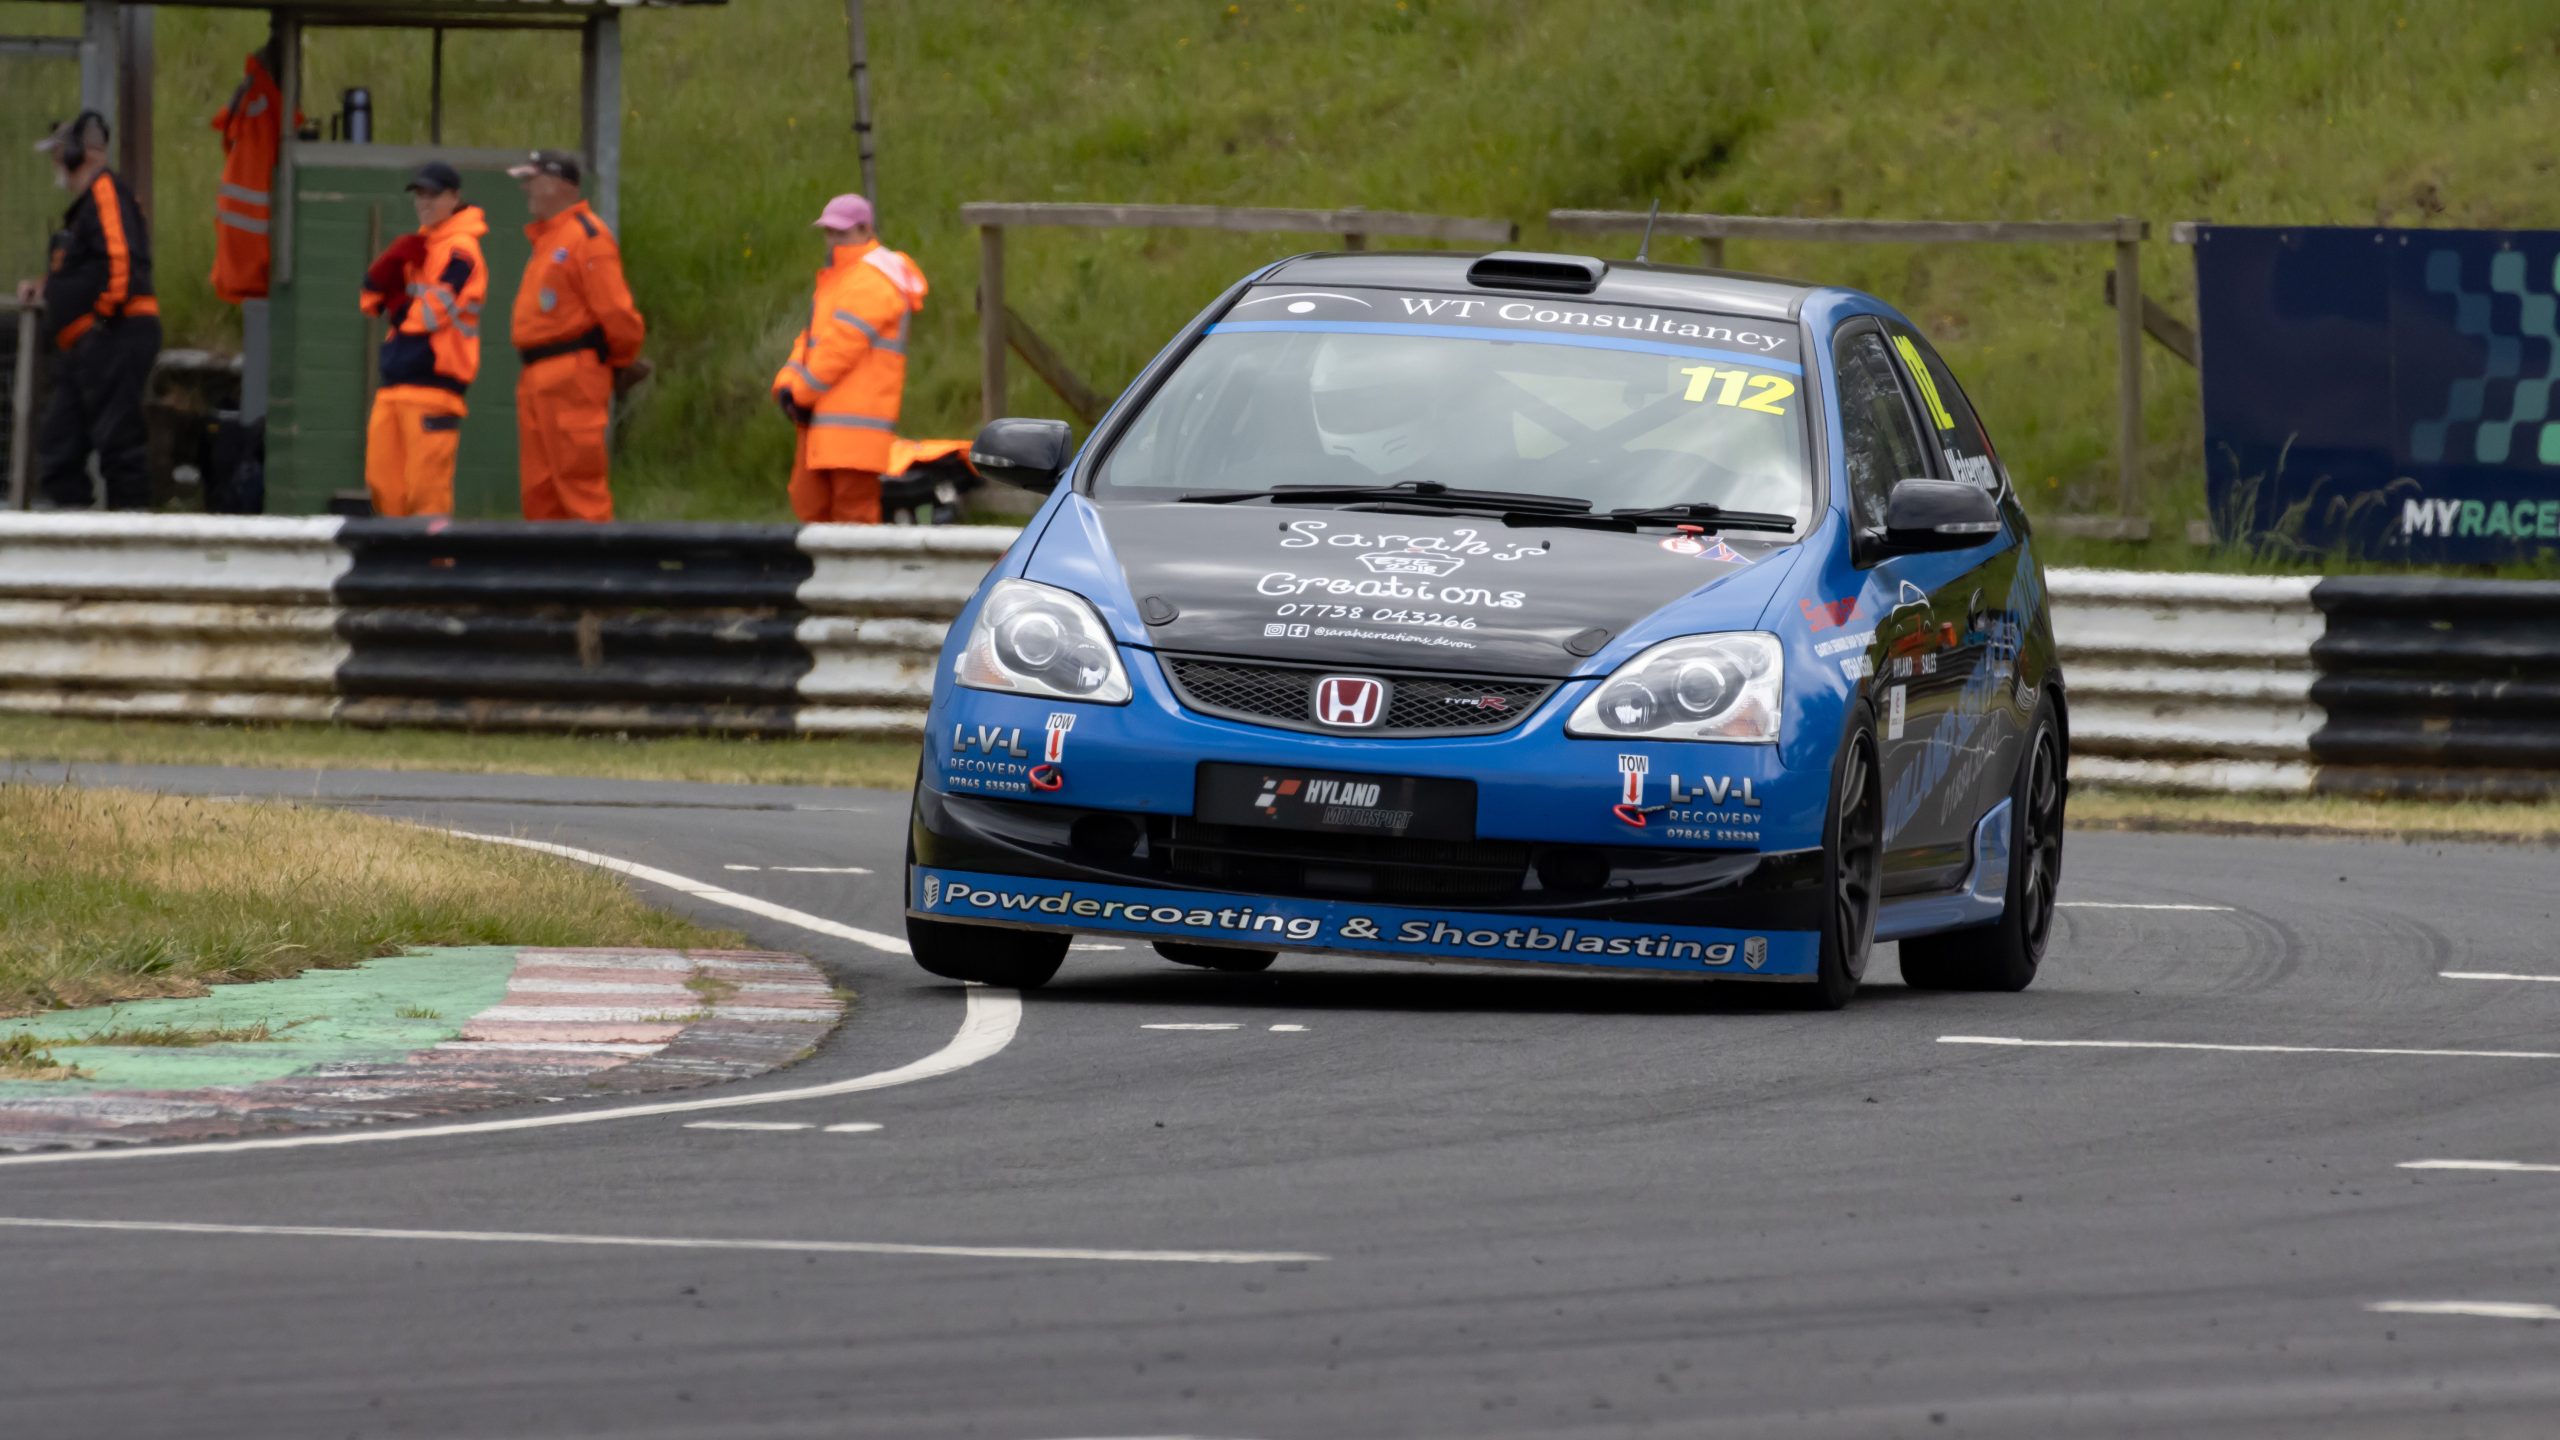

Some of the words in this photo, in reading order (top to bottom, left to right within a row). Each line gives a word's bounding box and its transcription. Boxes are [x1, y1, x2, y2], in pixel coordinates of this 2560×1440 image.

[1400, 298, 1484, 319] WT
[1498, 303, 1787, 351] Consultancy
[1680, 366, 1795, 415] 112
[2403, 498, 2560, 537] MYRACE
[1279, 520, 1547, 561] Sarah's
[1256, 571, 1527, 609] Creations
[1276, 603, 1364, 619] 07738
[1371, 608, 1478, 630] 043266
[1313, 626, 1477, 650] @sarahscreations_devon
[1921, 653, 1937, 674] SALES
[1444, 697, 1480, 705] TYPE
[1049, 714, 1074, 730] TOW
[953, 723, 1028, 757] L-V-L
[950, 757, 1027, 776] RECOVERY
[1620, 755, 1647, 773] TOW
[949, 775, 980, 789] 07845
[985, 780, 1027, 793] 535293
[1304, 779, 1381, 808] HYLAND
[1669, 773, 1761, 806] L-V-L
[1322, 806, 1413, 829] MOTORSPORT
[1669, 810, 1762, 825] RECOVERY
[1667, 828, 1710, 840] 07845
[944, 882, 1322, 940] Powdercoating
[1338, 916, 1380, 941] &
[1397, 920, 1736, 966] Shotblasting
